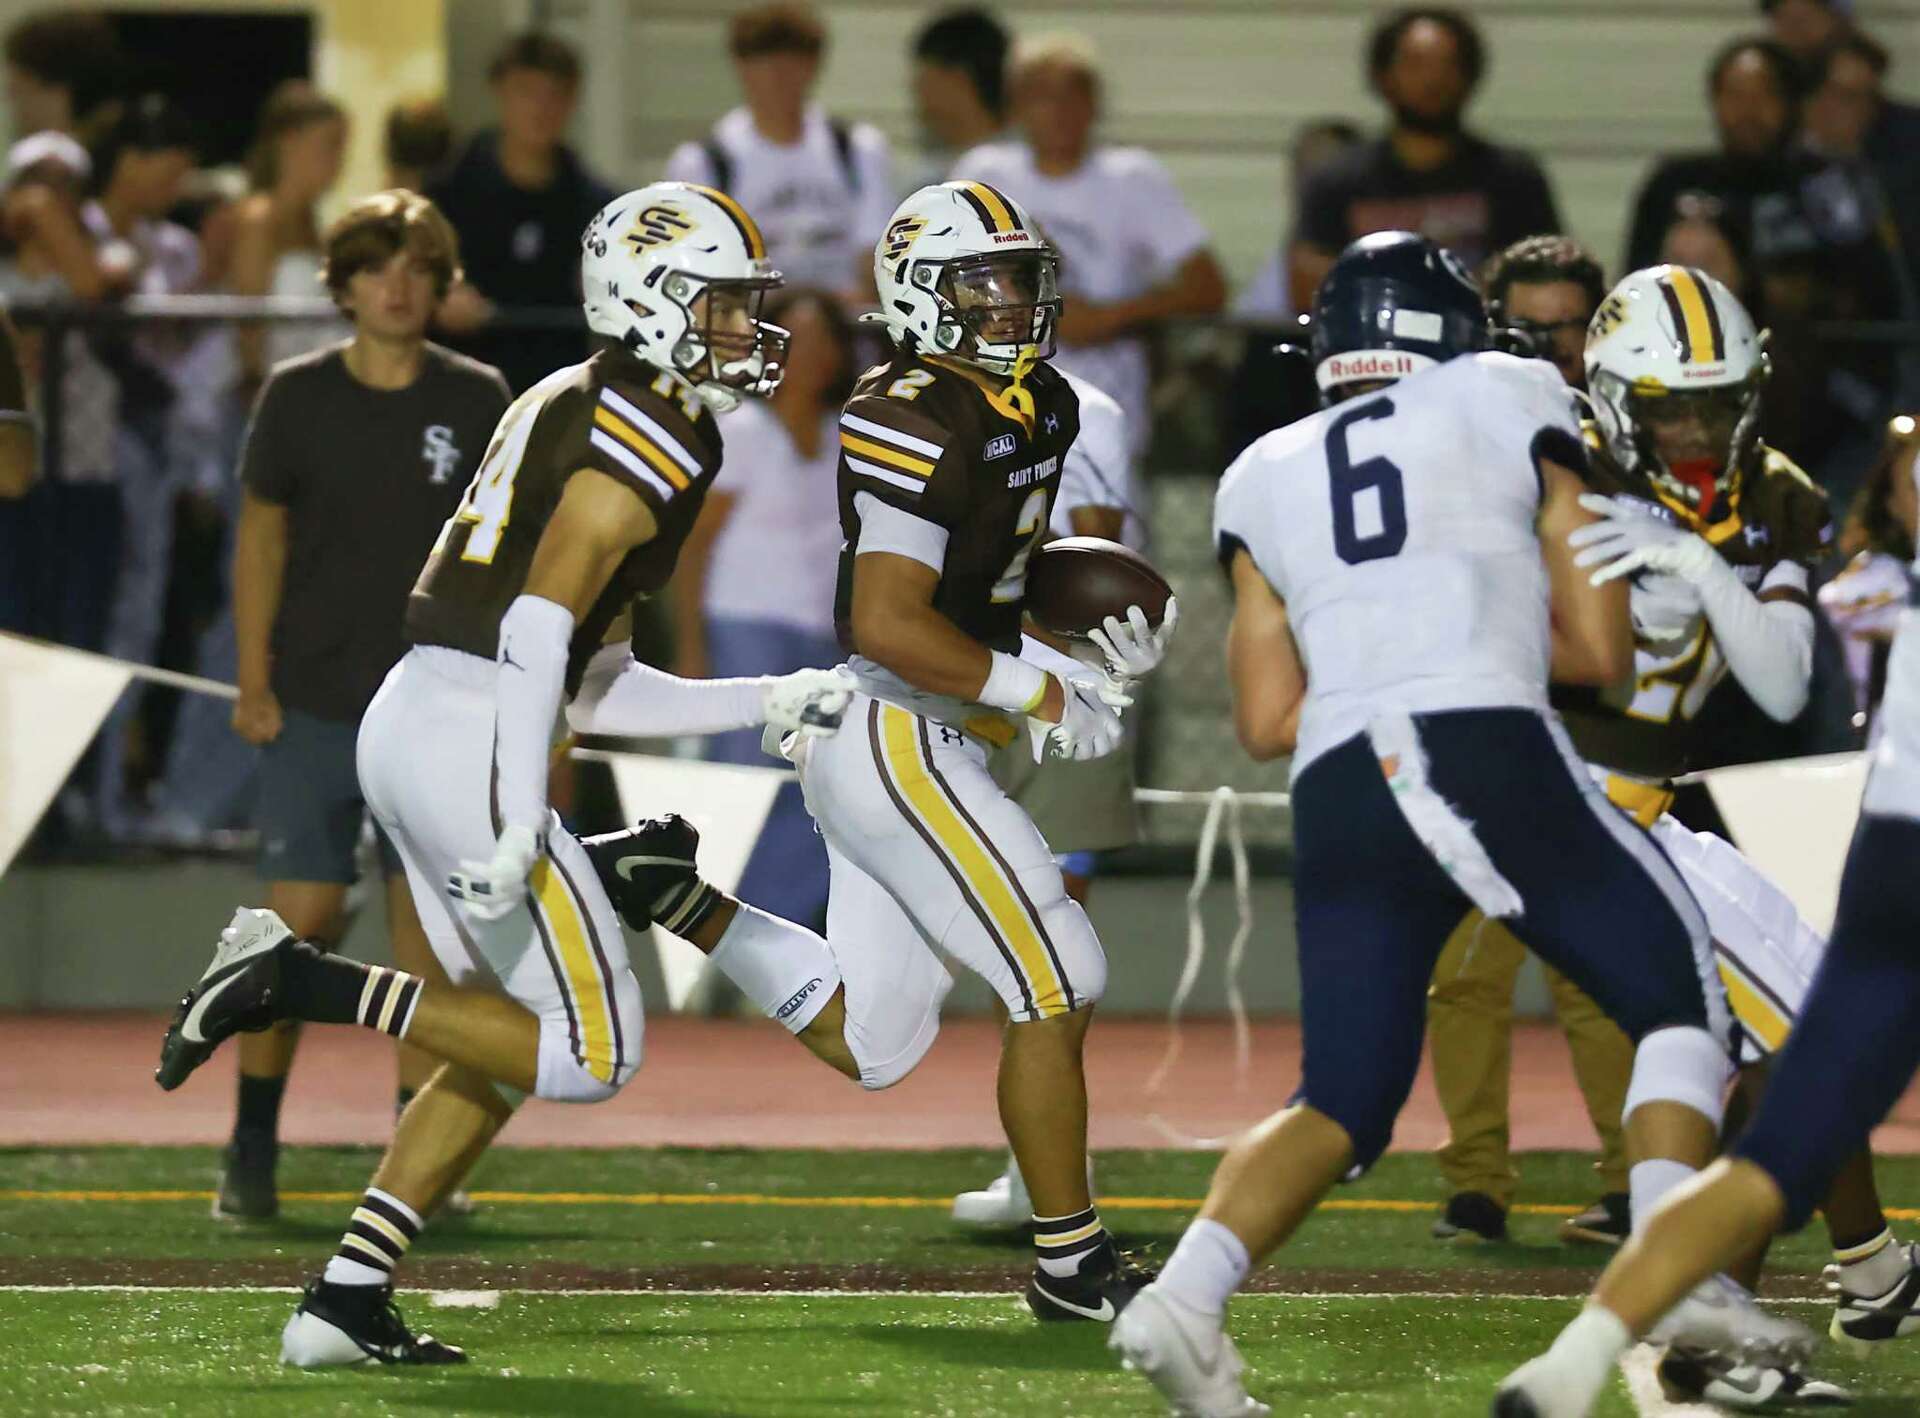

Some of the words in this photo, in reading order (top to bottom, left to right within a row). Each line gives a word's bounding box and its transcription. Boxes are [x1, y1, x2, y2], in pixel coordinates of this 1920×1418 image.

[993, 233, 1030, 244] Riddell
[608, 281, 619, 299] 14
[1330, 356, 1413, 377] Riddell
[887, 368, 936, 400] 2
[1325, 396, 1408, 565] 6
[989, 487, 1048, 603] 2
